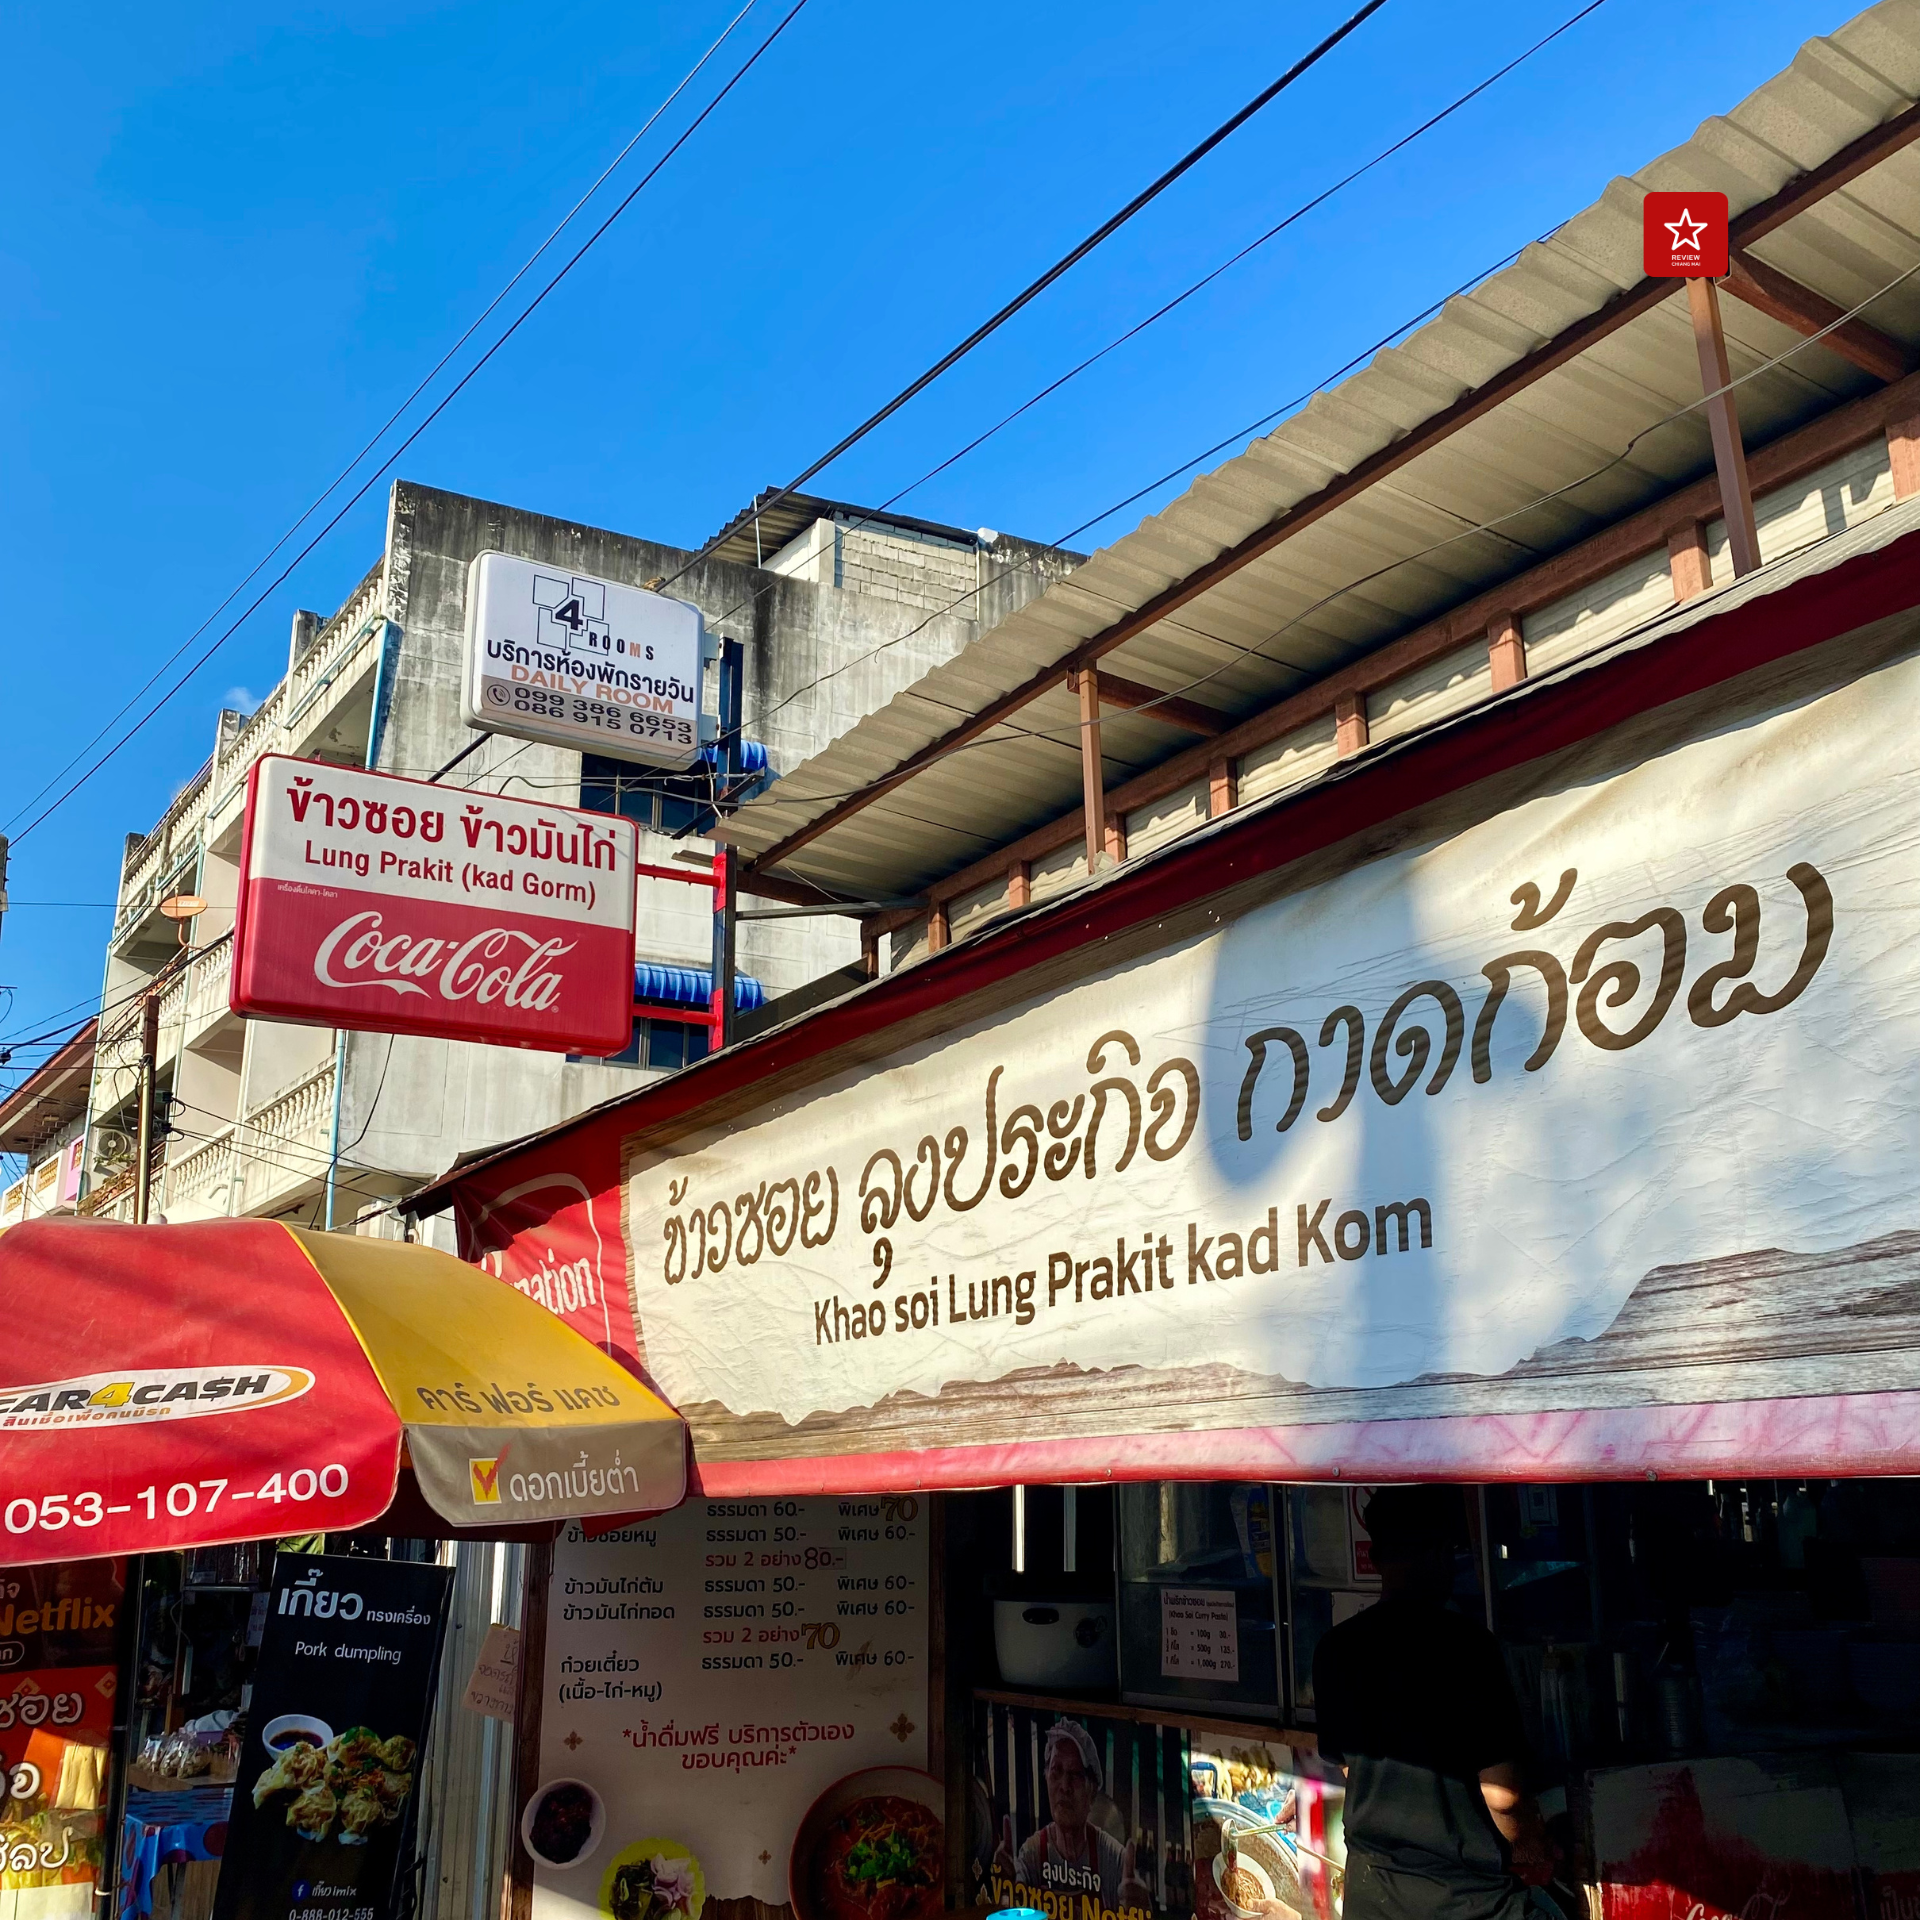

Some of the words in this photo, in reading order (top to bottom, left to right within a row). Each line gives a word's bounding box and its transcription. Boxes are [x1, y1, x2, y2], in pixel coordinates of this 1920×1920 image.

[555, 599, 583, 631] 4
[588, 631, 655, 661] ROOMS
[487, 639, 694, 704] บริการห้องพักรายวัน
[511, 664, 589, 695] DAILY
[595, 685, 674, 714] ROOM
[513, 699, 564, 718] 086
[573, 711, 622, 730] 915
[629, 723, 692, 745] 0713
[514, 687, 565, 706] 099
[573, 699, 622, 718] 386
[629, 710, 692, 734] 6653
[286, 775, 444, 843] ข้าวซอย
[460, 804, 617, 872] ข้าวมันไก่
[305, 840, 370, 876] Lung
[380, 851, 453, 883] Prakit
[462, 863, 514, 893] (kad
[523, 873, 596, 910] Gorm)
[313, 911, 579, 1011] Coca-Cola
[664, 1176, 838, 1285] ข้าวซอย
[859, 1030, 1200, 1289] ลุงประกิจ
[815, 1297, 886, 1346] Khao
[895, 1276, 939, 1333] soi
[949, 1268, 1036, 1326] Lung
[1048, 1233, 1174, 1307] Prakit
[1187, 1206, 1279, 1285] kad
[1298, 1197, 1433, 1268] Kom
[416, 1382, 482, 1414] คาร์
[480, 1382, 554, 1415] ฟอร์
[553, 1385, 621, 1411] แคช
[509, 1450, 640, 1502] ดอกเบี้ยต่ำ
[5, 1463, 348, 1534] 053-107-400
[707, 1504, 767, 1517] ธรรมดา
[838, 1502, 879, 1517] พิเศษ
[880, 1496, 918, 1522] 70
[567, 1526, 657, 1548] ข้าอยหมู
[706, 1529, 766, 1542] ธรรมดา
[838, 1527, 879, 1541] พิเศษ
[705, 1554, 737, 1567] รวม
[744, 1552, 754, 1566] 2
[761, 1550, 801, 1567] อย่าง
[277, 1569, 363, 1620] เกี๊ยว
[366, 1605, 431, 1625] ทรงเครื่อง
[565, 1577, 663, 1595] ข้าวมันไก่ต้ม
[704, 1580, 765, 1593] ธรรมดา
[837, 1576, 879, 1590] พิเศษ
[563, 1603, 675, 1620] ข้าวมันไก่ทอด
[704, 1605, 764, 1618] ธรรมดา
[837, 1601, 879, 1615] พิเศษ
[703, 1631, 734, 1643] รวม
[741, 1628, 752, 1643] 2
[758, 1626, 799, 1642] อย่าง
[801, 1622, 841, 1650] 70
[295, 1641, 327, 1657] Pork
[334, 1643, 401, 1665] dumpling
[561, 1650, 639, 1673] ก๋วยเตี๋ยว
[702, 1656, 763, 1669] ธรรมดา
[835, 1651, 877, 1666] พิเศษ
[559, 1677, 663, 1703] (เนื้อ-ไก่-หมู)
[728, 1721, 855, 1745] บริการตัวเอง
